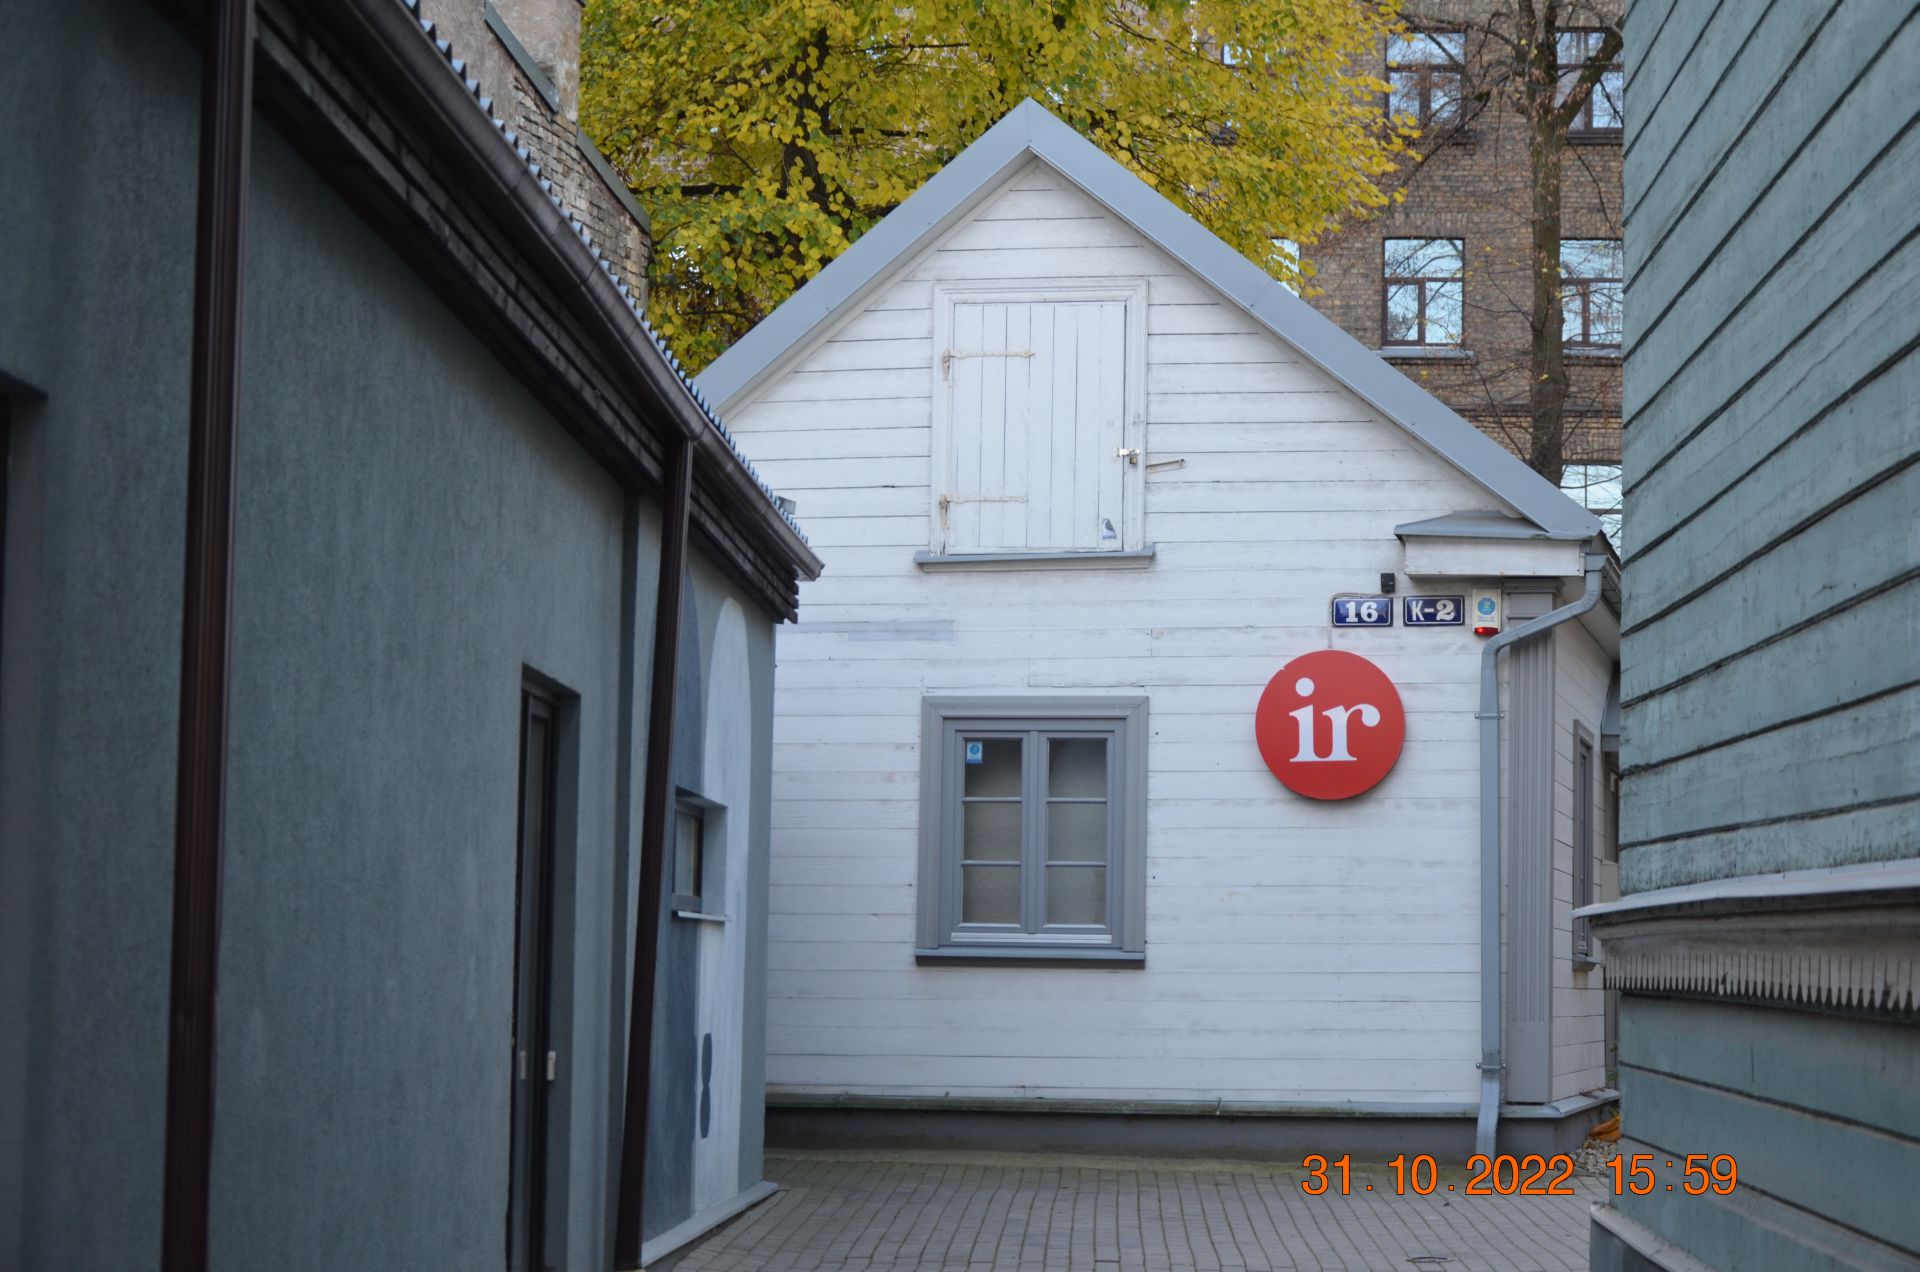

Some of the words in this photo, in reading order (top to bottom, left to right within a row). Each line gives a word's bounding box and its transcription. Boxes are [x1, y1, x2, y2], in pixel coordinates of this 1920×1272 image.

[1345, 601, 1378, 623] 16
[1411, 599, 1456, 622] K-2
[1288, 677, 1381, 763] ir
